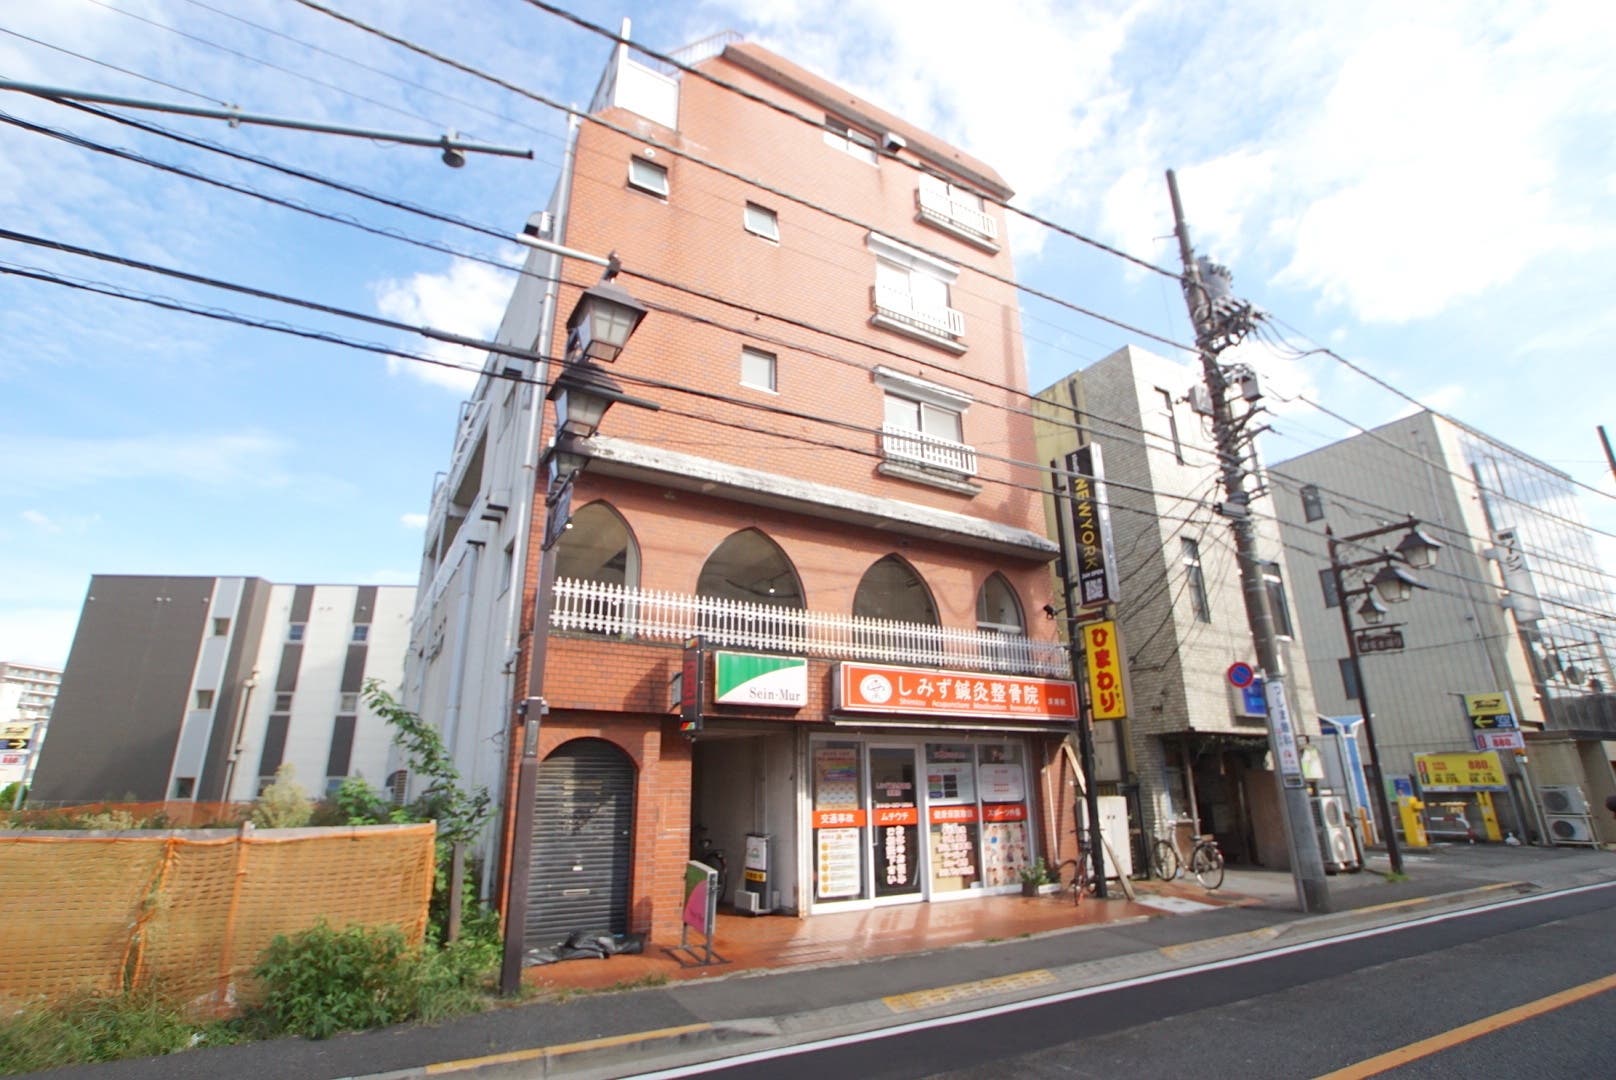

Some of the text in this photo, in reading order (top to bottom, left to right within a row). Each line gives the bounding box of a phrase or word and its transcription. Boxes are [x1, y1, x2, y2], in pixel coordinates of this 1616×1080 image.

[1091, 627, 1115, 713] ひまわり
[898, 676, 1039, 704] しみず鍼灸整骨院
[821, 813, 854, 825] 交通事故
[881, 812, 909, 822] ムチウチ
